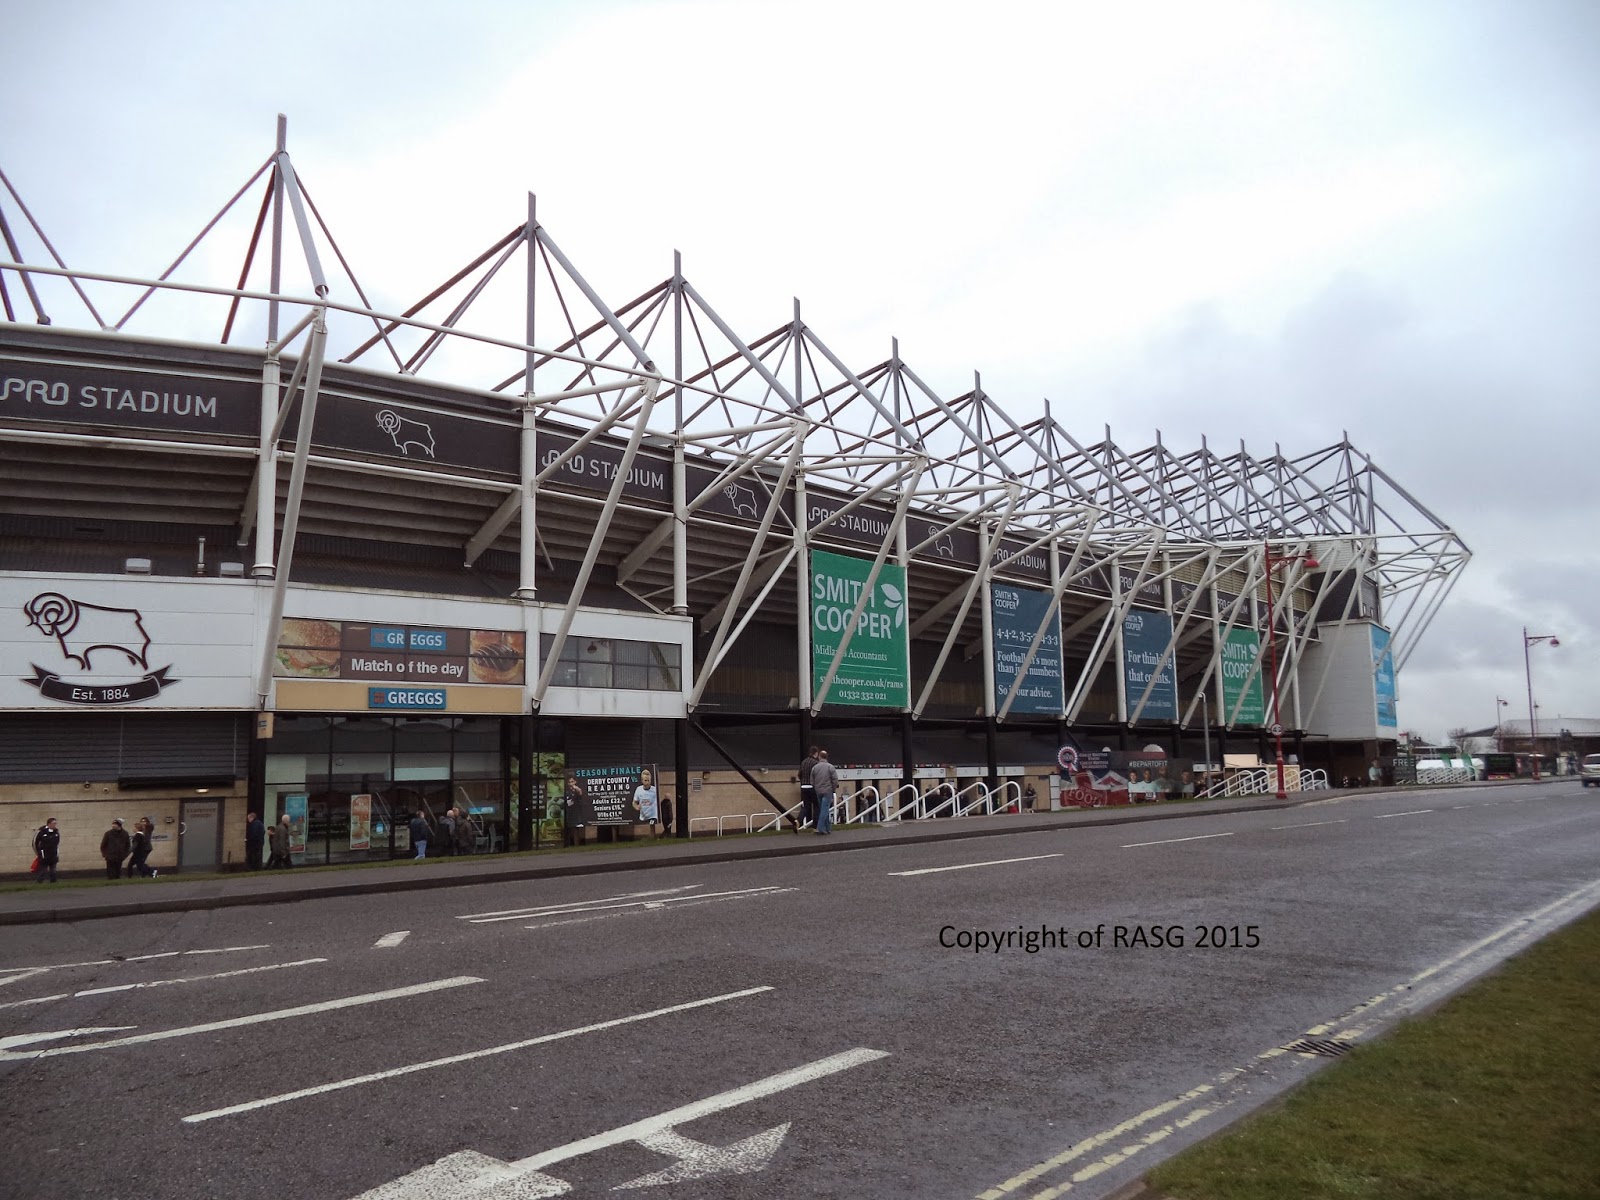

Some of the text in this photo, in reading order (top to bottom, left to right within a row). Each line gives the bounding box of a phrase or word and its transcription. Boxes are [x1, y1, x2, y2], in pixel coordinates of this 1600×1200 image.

[79, 385, 217, 418] STADIUM
[839, 514, 890, 536] STADIUM
[1010, 552, 1046, 571] ADIUM
[994, 589, 1012, 600] SMITH
[994, 598, 1016, 610] COOPER
[814, 604, 892, 640] COOPER
[1125, 621, 1142, 631] COOPER
[815, 644, 888, 661] Midlas Accountants
[1127, 649, 1142, 664] For
[351, 658, 393, 673] Match
[416, 661, 438, 674] the
[440, 662, 464, 678] day
[1041, 657, 1058, 667] more
[997, 661, 1014, 674] than
[1029, 666, 1060, 678] numbers.
[1128, 668, 1171, 684] that conts.
[71, 687, 130, 701] Est. 1884
[387, 691, 443, 705] GREGGS
[838, 690, 887, 701] 01332 332 021
[998, 684, 1008, 695] So
[1029, 686, 1053, 698] advice.
[1392, 758, 1415, 767] FREE
[576, 766, 641, 777] SEASON FINALE
[587, 777, 606, 786] DERBY
[606, 776, 630, 785] COUNTY
[587, 783, 630, 792] READING
